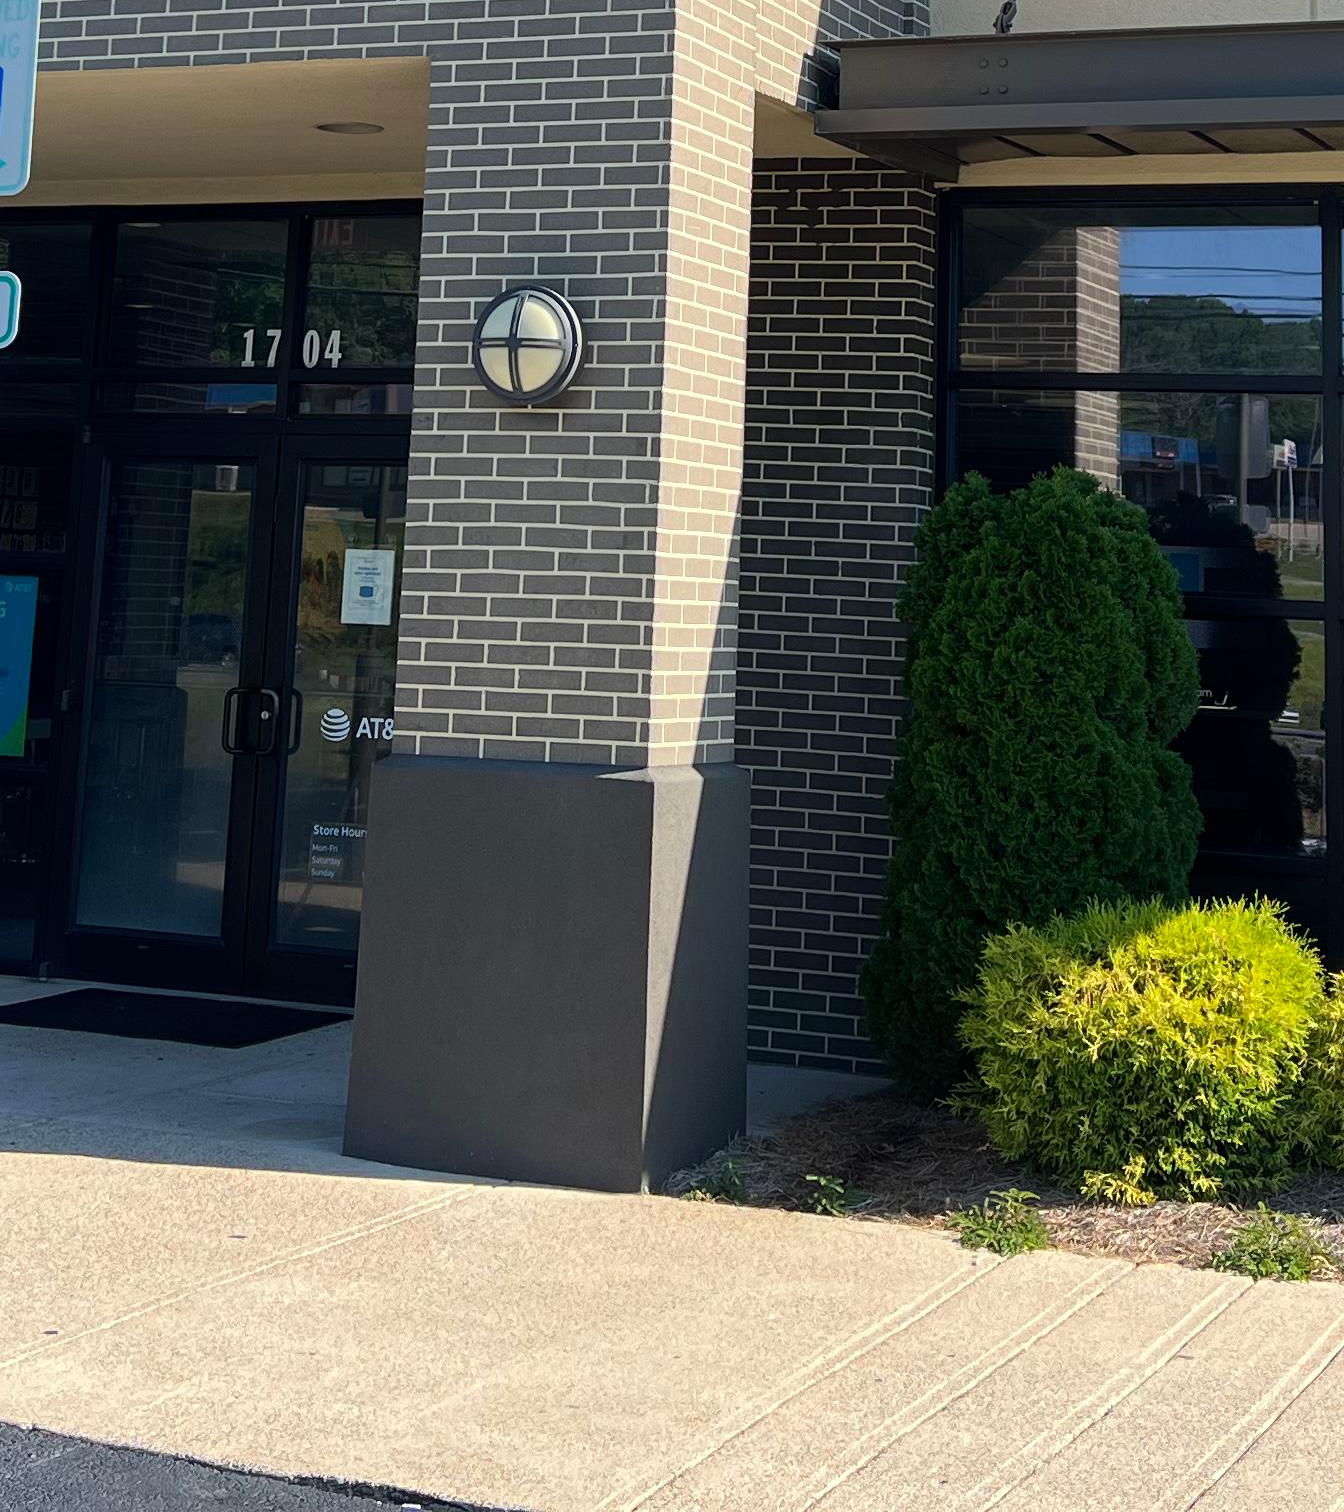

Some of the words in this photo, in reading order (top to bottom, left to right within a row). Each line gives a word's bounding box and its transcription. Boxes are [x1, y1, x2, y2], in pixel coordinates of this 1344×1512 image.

[241, 328, 342, 369] 1704
[355, 716, 394, 741] AT&
[312, 824, 340, 837] Store
[340, 826, 368, 839] Hour
[311, 855, 343, 867] Saturday
[311, 868, 336, 879] Sunday
